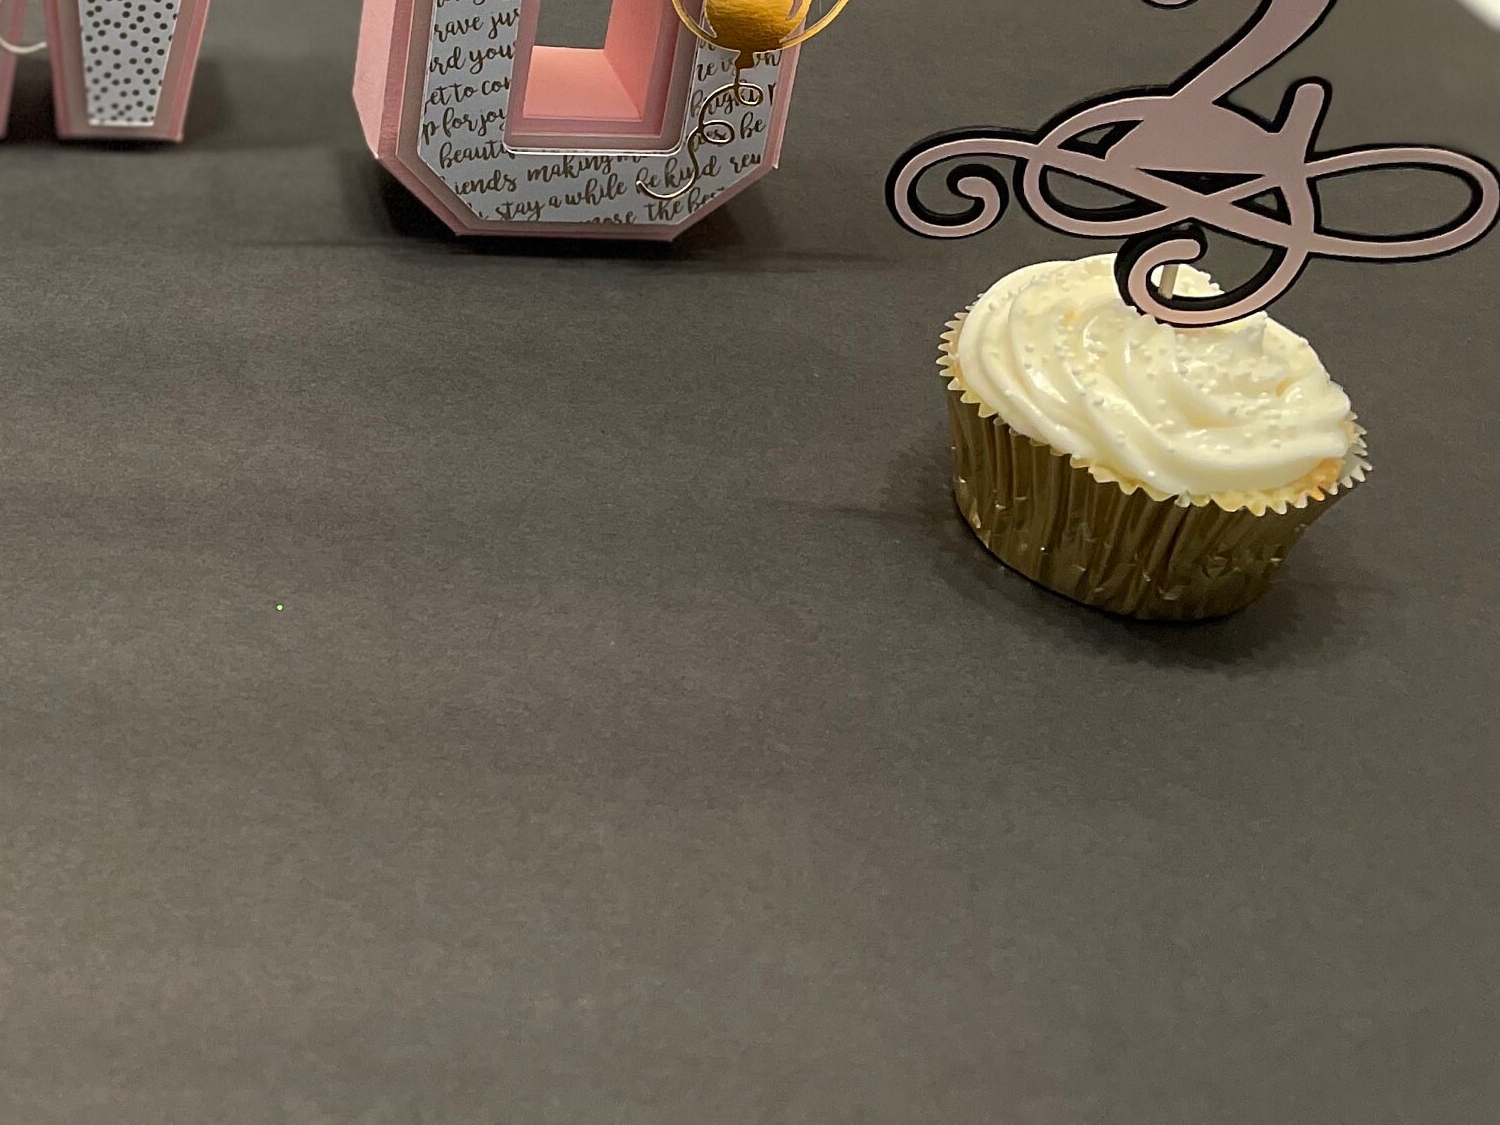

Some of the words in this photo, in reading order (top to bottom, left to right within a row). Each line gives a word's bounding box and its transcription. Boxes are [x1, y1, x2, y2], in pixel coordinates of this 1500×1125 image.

[448, 83, 480, 104] to
[442, 106, 478, 138] for
[740, 111, 765, 140] be
[439, 141, 516, 170] beauti
[453, 169, 518, 195] iends
[549, 194, 562, 209] a
[565, 170, 628, 206] while
